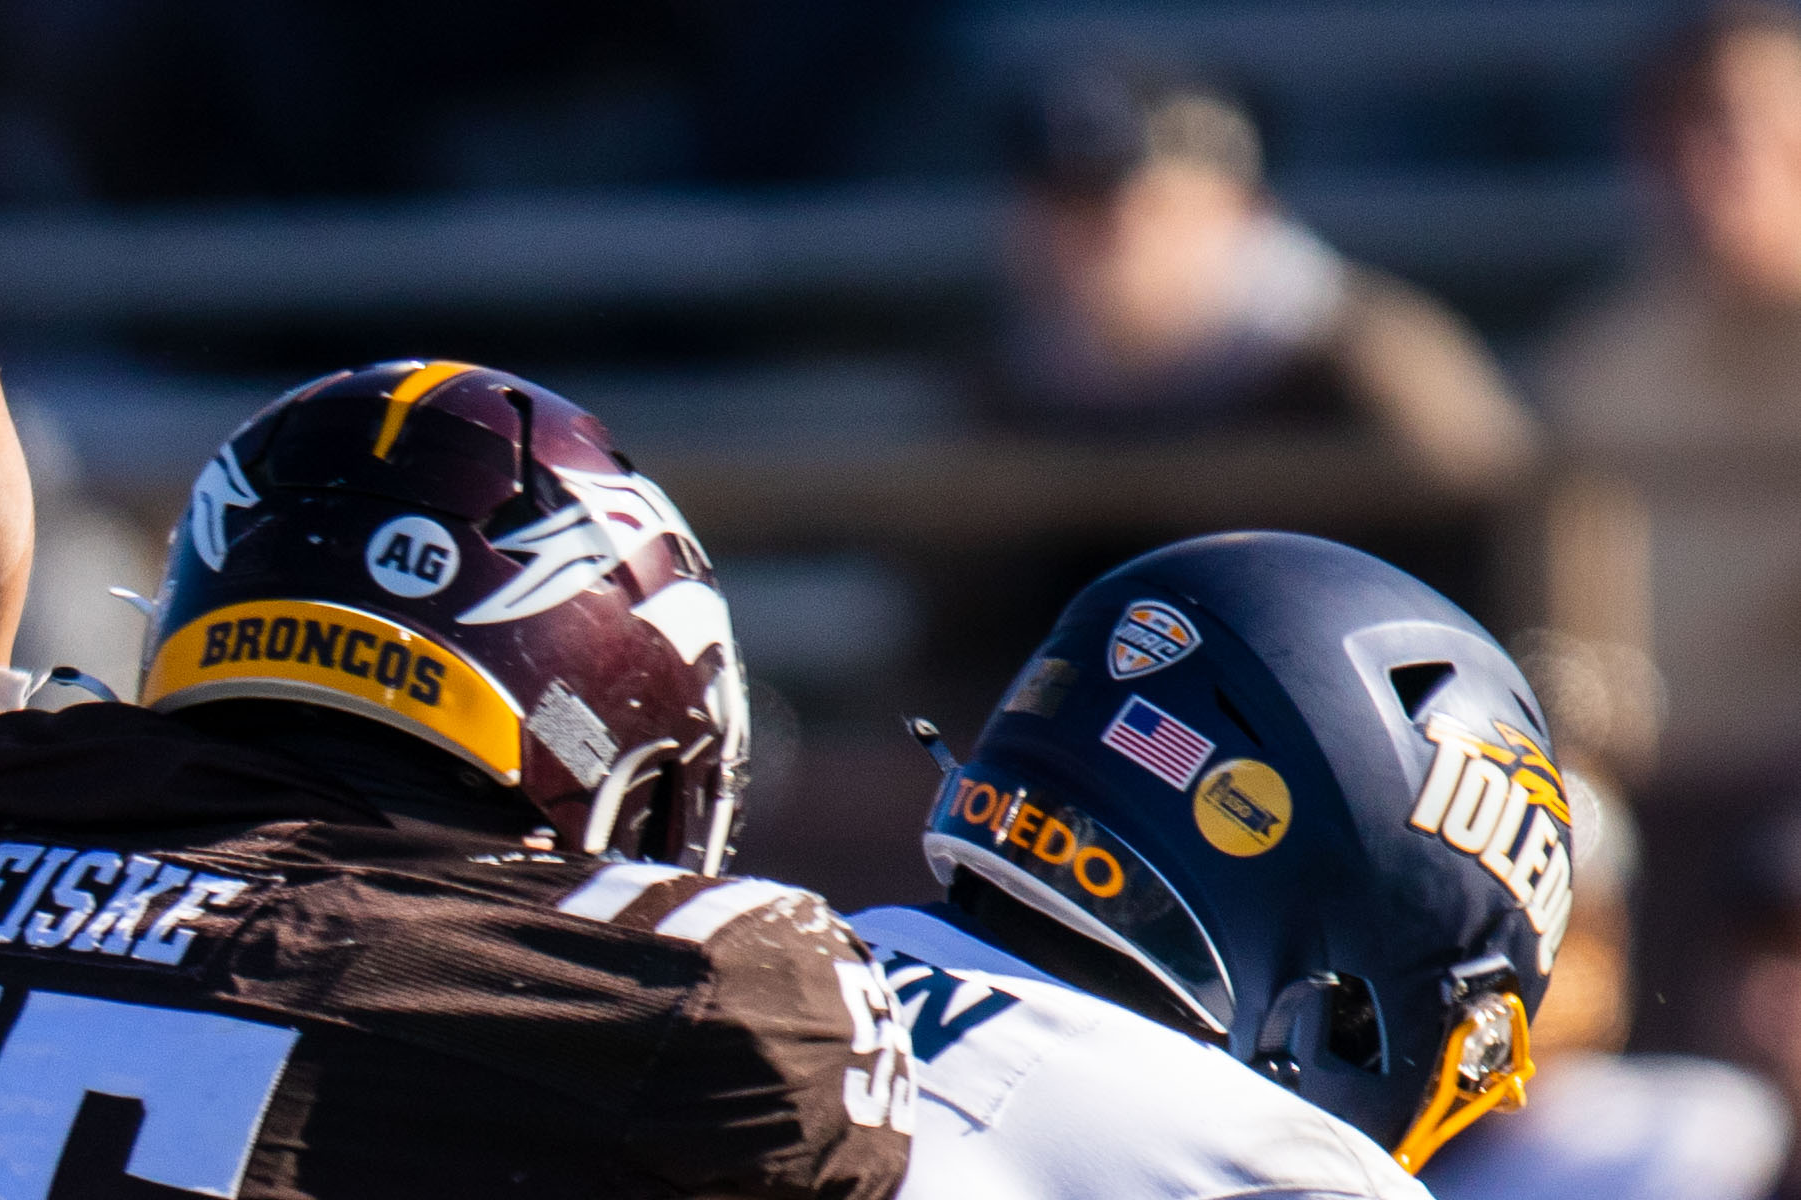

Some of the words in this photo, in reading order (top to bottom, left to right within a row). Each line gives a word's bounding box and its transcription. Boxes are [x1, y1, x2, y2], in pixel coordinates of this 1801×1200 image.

[376, 532, 451, 585] AG
[200, 616, 446, 706] BRONCOS
[950, 778, 1125, 899] TOLEDO
